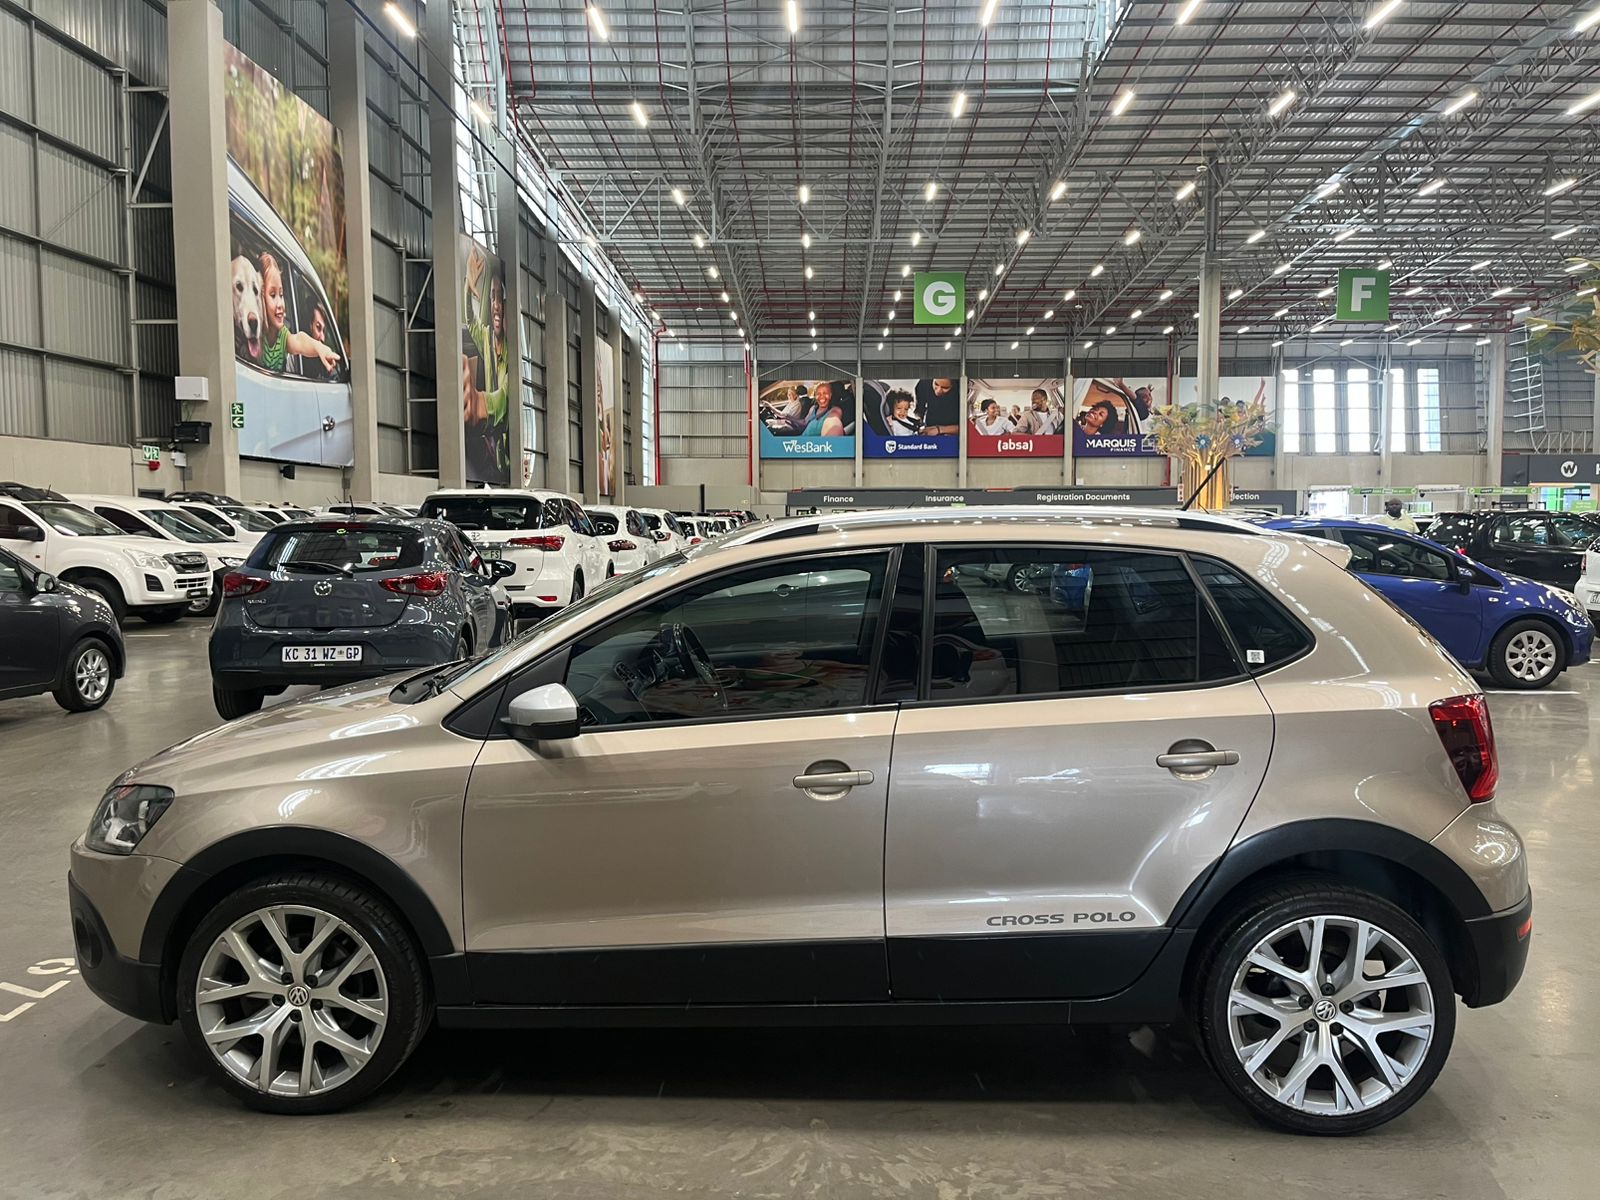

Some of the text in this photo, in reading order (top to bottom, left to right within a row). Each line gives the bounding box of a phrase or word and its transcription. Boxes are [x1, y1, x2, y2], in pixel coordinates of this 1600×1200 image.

[923, 281, 956, 316] G
[1351, 277, 1376, 311] F
[783, 440, 832, 453] WesBank
[997, 440, 1033, 452] (absa)
[1086, 439, 1137, 448] MARQUIS
[1036, 494, 1084, 502] Registration
[284, 647, 360, 660] KC 31 WZ GP
[986, 911, 1136, 926] CROSS POLO
